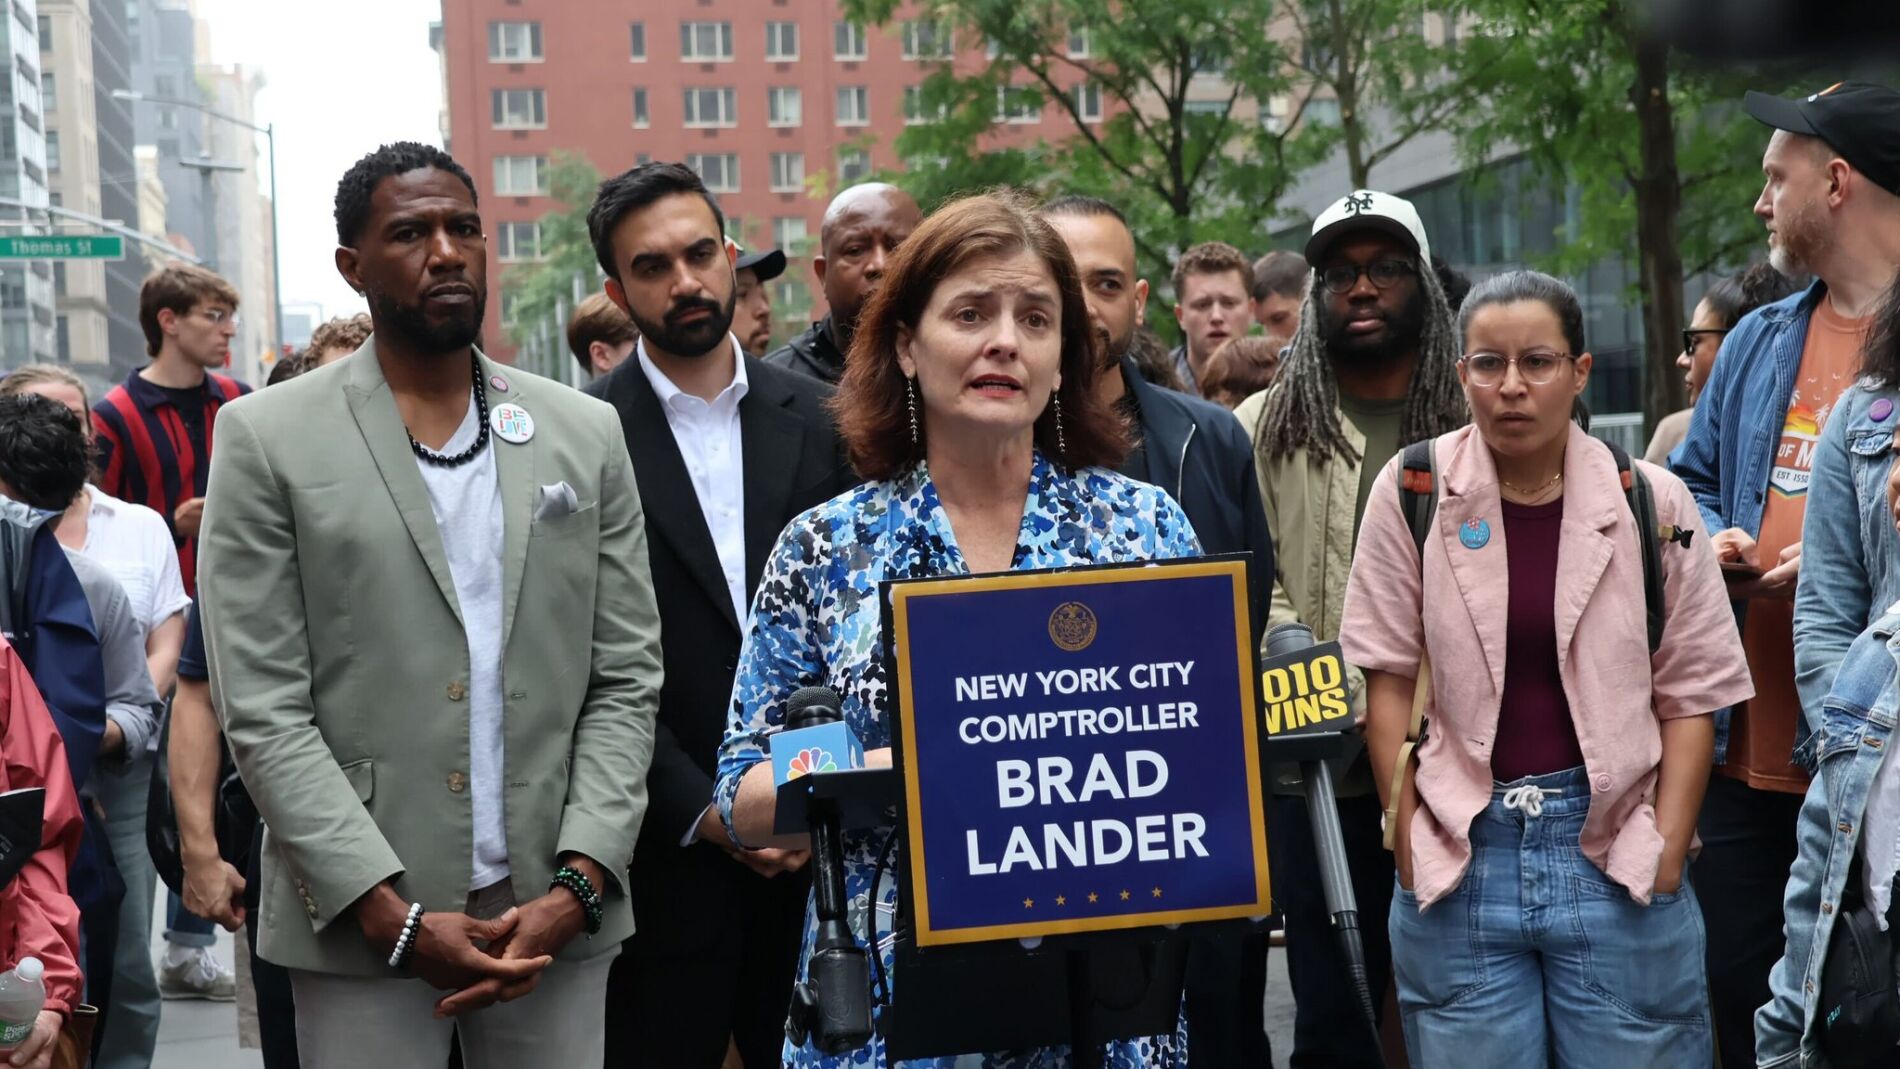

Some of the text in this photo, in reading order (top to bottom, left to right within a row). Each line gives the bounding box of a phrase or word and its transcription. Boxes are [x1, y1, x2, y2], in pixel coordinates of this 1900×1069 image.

[11, 239, 92, 255] Thomas St
[1777, 443, 1796, 458] OF
[955, 660, 1195, 702] NEW YORK CITY
[958, 702, 1200, 745] COMPTROLLER
[996, 749, 1169, 809] BRAD
[966, 812, 1210, 876] LANDER
